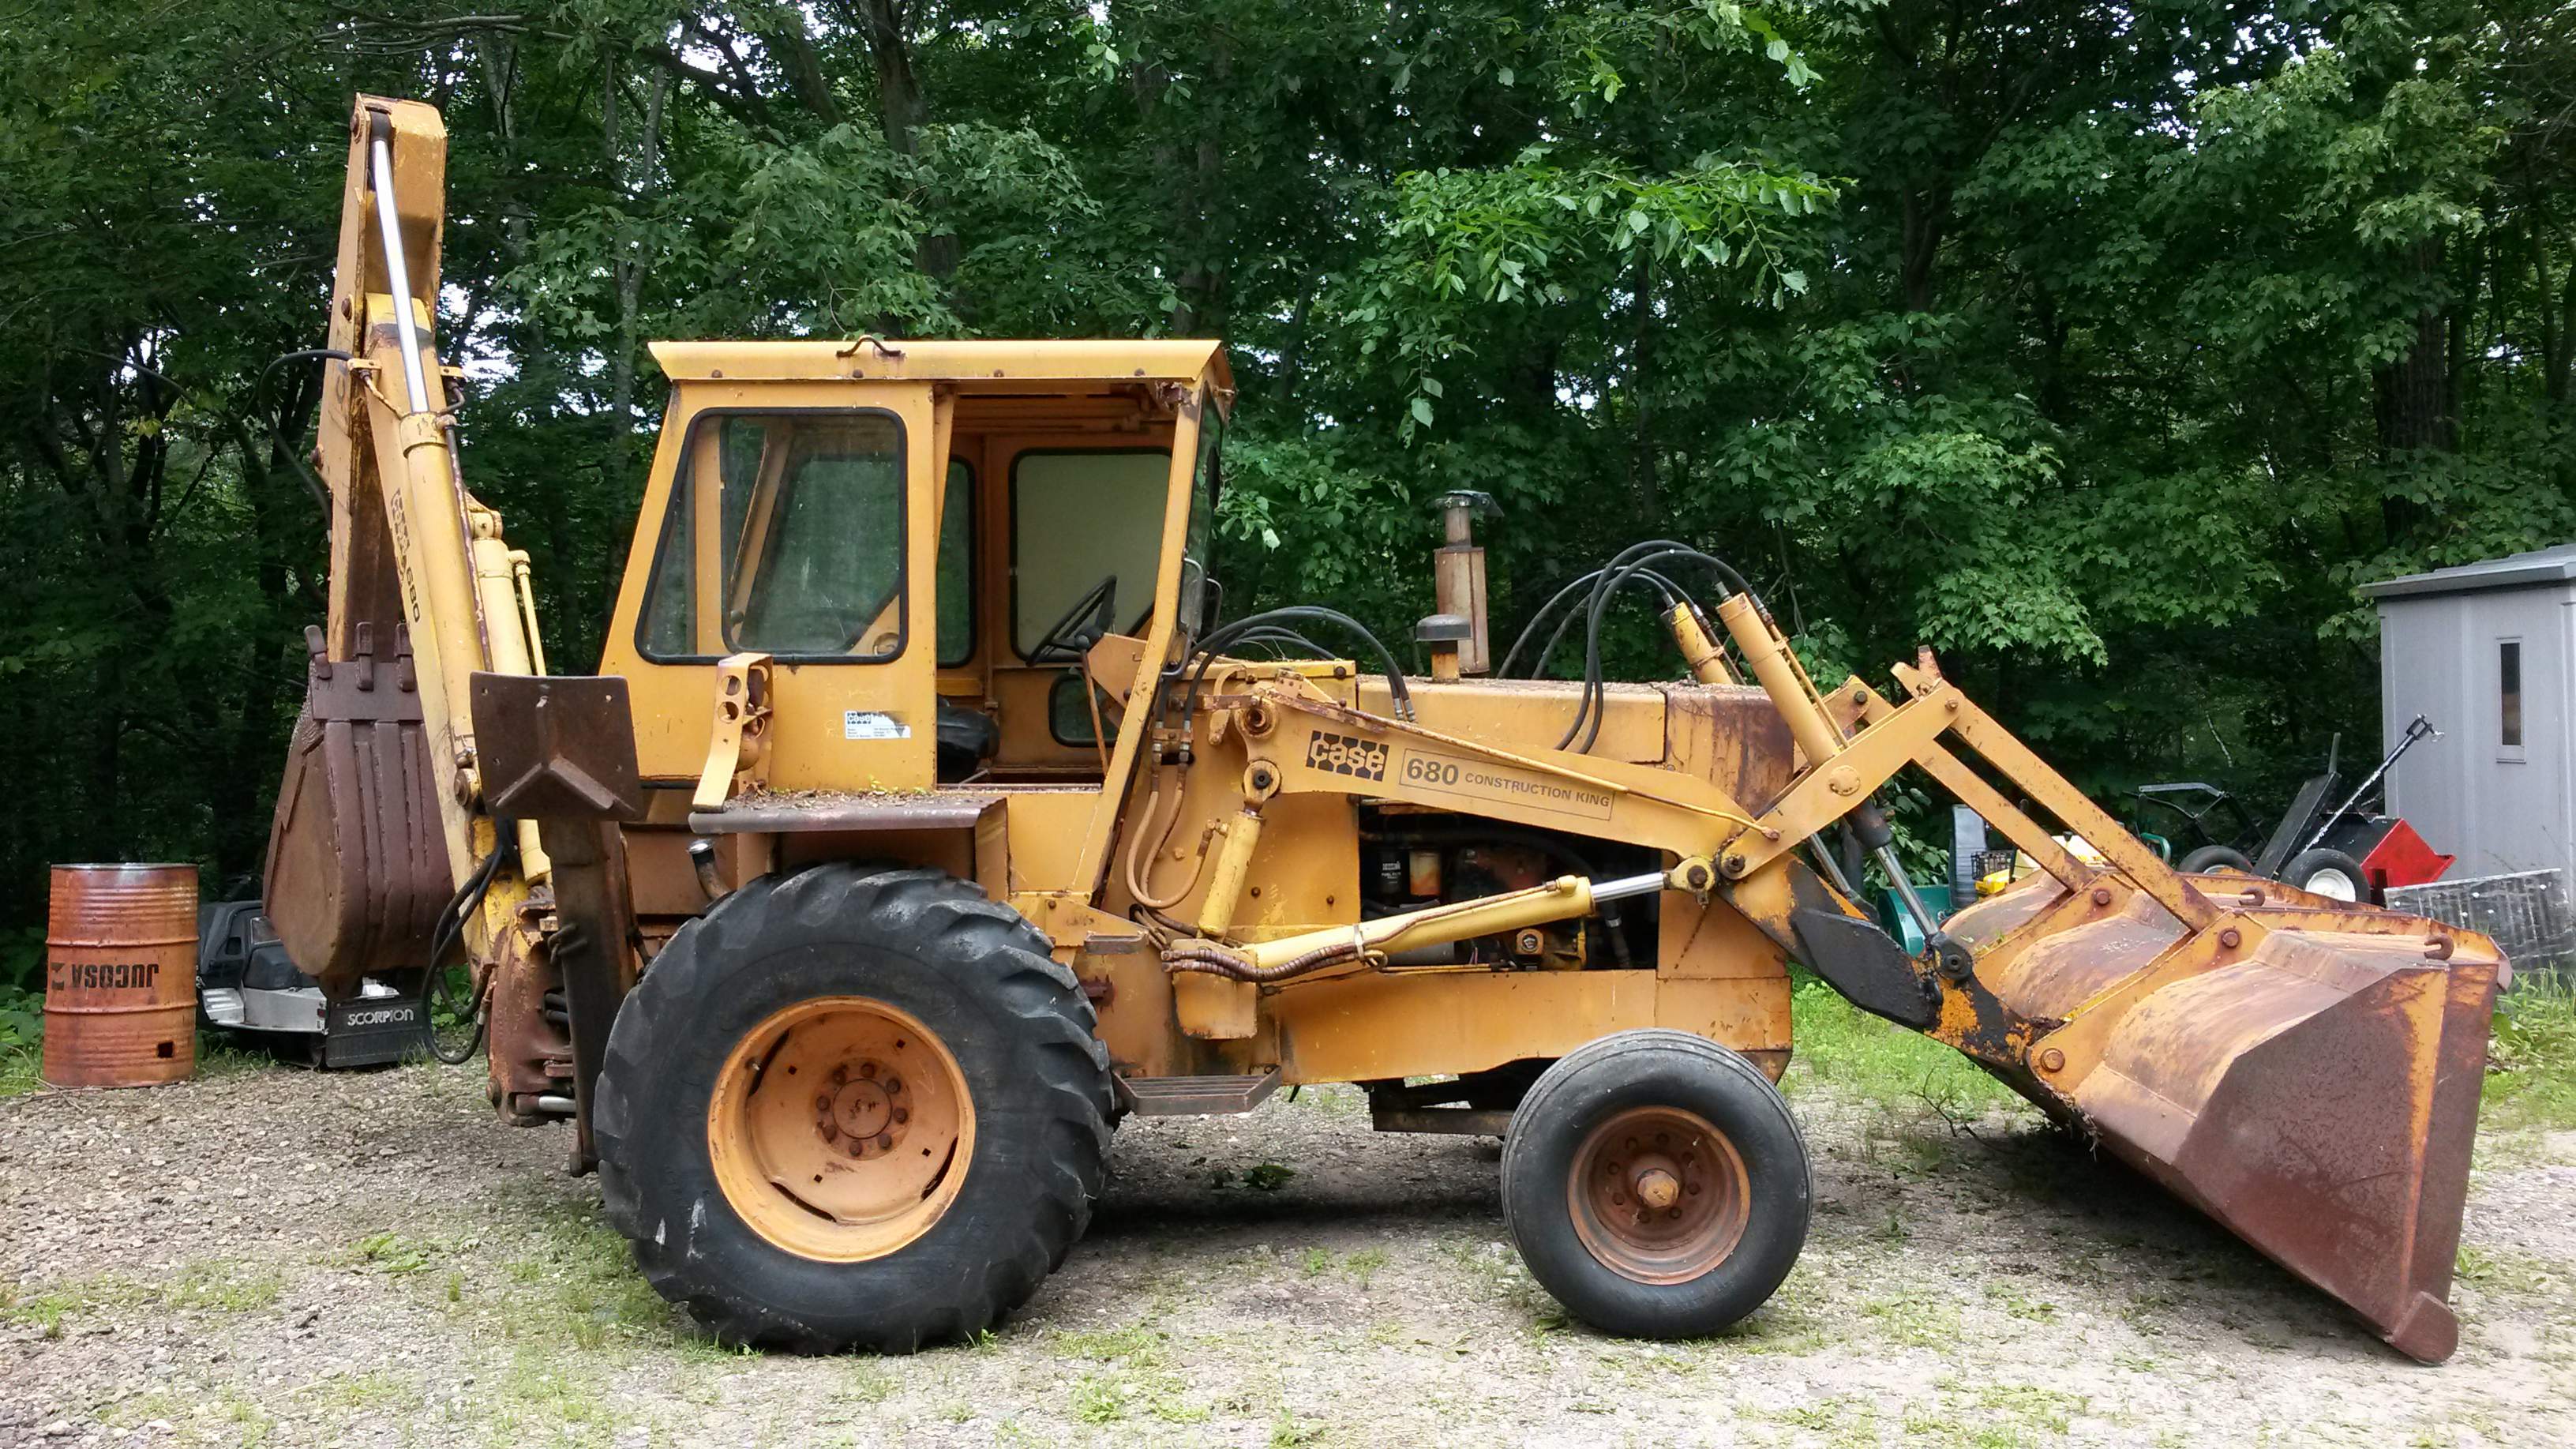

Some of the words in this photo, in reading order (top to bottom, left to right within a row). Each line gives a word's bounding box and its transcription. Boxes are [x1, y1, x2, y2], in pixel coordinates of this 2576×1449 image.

[406, 566, 421, 623] 680
[1407, 758, 1459, 786] 680
[1465, 772, 1572, 801] CONSTRUCTION
[1577, 791, 1610, 808] KING
[71, 963, 159, 989] JUCOSA
[347, 1008, 414, 1027] SCORPION
